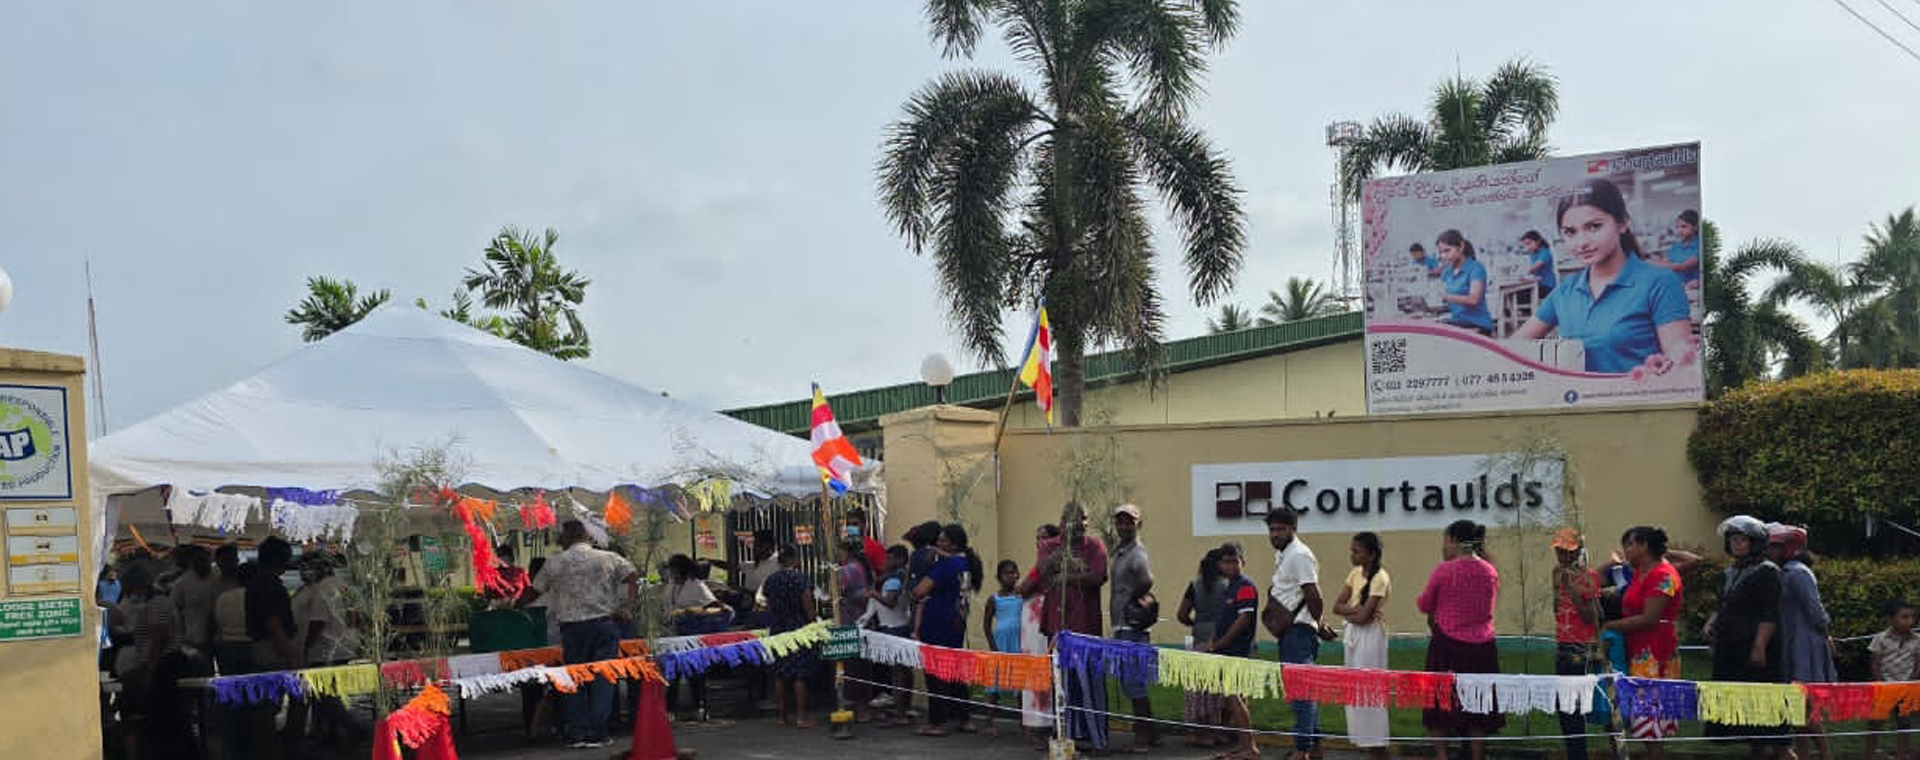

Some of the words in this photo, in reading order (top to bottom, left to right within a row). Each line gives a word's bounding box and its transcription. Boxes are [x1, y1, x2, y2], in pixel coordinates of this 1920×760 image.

[1462, 374, 1482, 386] 077
[1282, 473, 1544, 515] Courtaulds
[38, 600, 76, 610] METAL
[38, 608, 71, 618] ZONE
[821, 643, 859, 656] LOADING
